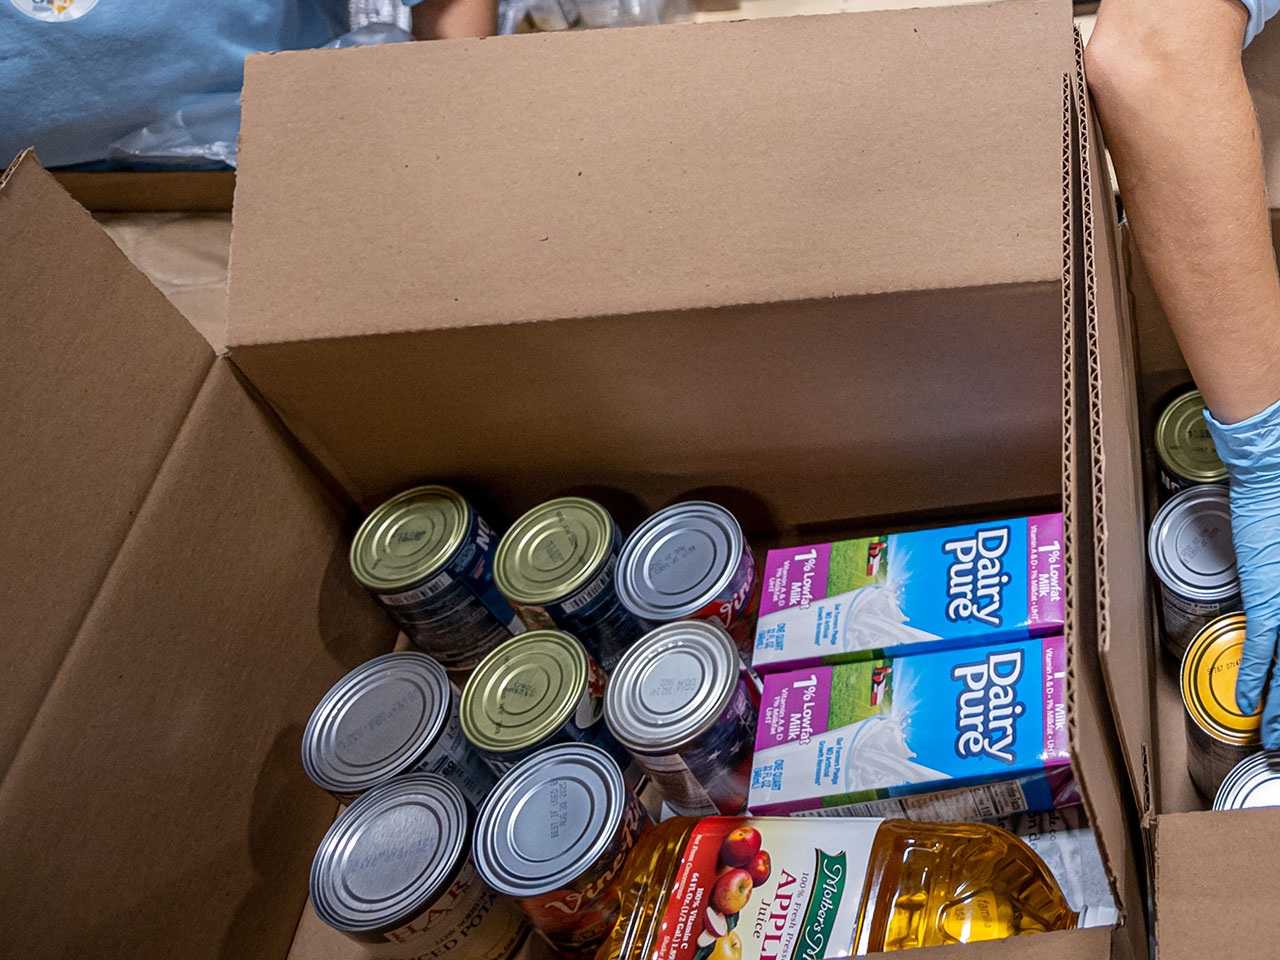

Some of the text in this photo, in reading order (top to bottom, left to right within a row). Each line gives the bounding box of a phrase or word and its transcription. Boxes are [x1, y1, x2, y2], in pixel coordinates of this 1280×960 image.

[1030, 524, 1038, 548] Vitamin
[794, 548, 817, 610] 1% Lowfat
[944, 539, 977, 620] Pure
[972, 528, 1009, 625] Dairy
[1038, 540, 1062, 602] 1% Lowfat
[1038, 573, 1048, 598] Milk
[789, 581, 802, 606] Milk
[1046, 647, 1054, 675] Vitamin
[779, 687, 788, 719] Vitamin
[793, 674, 817, 744] 1% Lowfat
[954, 663, 988, 755] Pure
[983, 652, 1023, 761] Dairy
[1055, 703, 1066, 730] Milk
[787, 713, 801, 740] Milk
[695, 834, 703, 846] Not
[676, 862, 693, 900] Concentrate
[694, 872, 700, 881] 64
[795, 872, 809, 899] 100%
[811, 858, 843, 933] Mother's
[460, 893, 498, 938] POTA
[680, 888, 704, 950] 100% Vitamin C
[753, 898, 771, 939] Juice
[790, 900, 802, 930] Fresh
